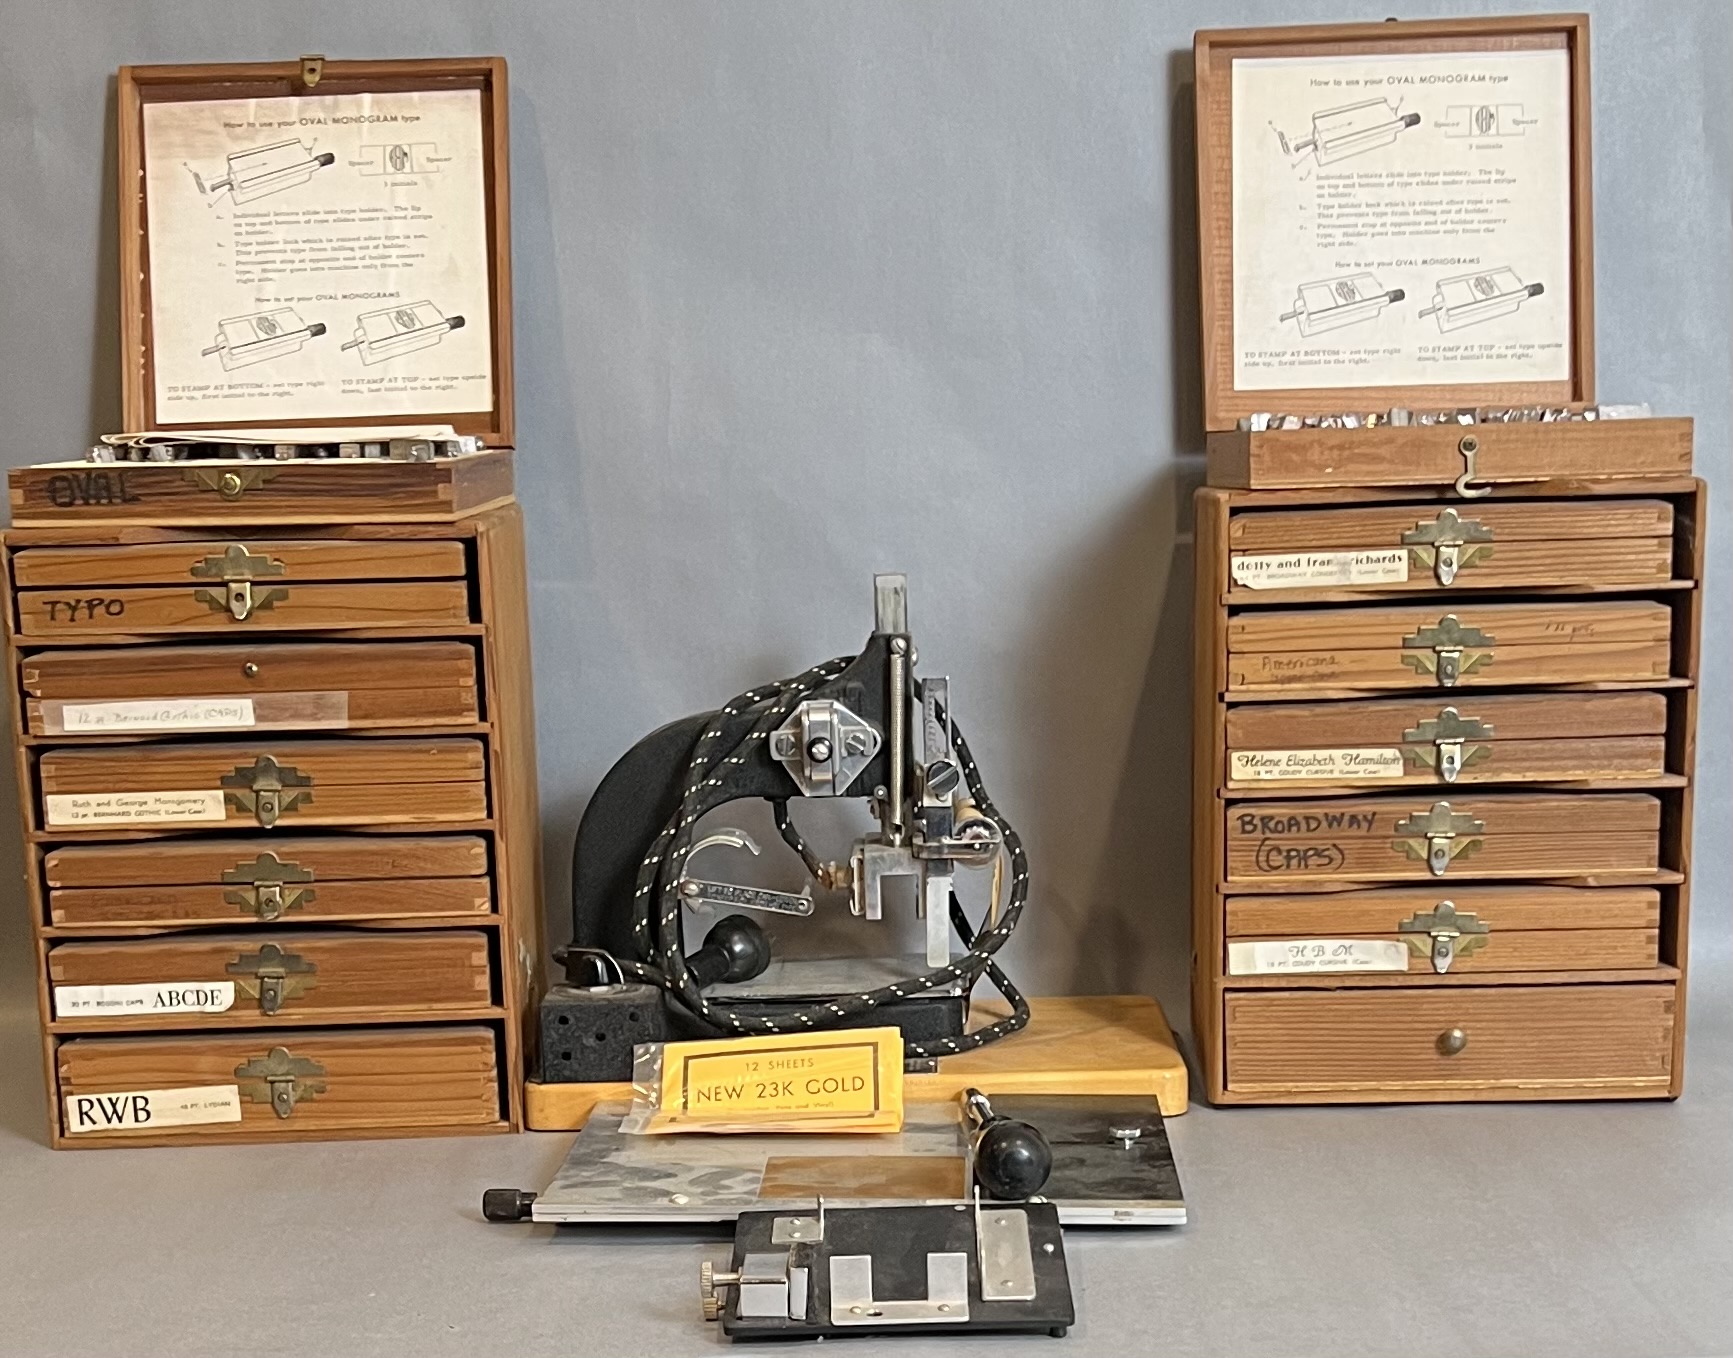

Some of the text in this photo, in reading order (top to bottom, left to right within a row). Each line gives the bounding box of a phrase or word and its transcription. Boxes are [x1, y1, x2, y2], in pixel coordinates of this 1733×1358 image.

[1310, 78, 1330, 88] How
[1333, 78, 1342, 86] to
[1386, 76, 1416, 86] OVAL
[1419, 74, 1486, 84] MONOGRAM
[1489, 75, 1508, 84] type
[300, 118, 328, 126] OVAL
[332, 115, 398, 124] MONOGRAM
[401, 115, 420, 124] type
[1421, 257, 1480, 266] MONOGRAMS
[1290, 350, 1302, 358] AT
[1418, 346, 1430, 354] TO
[1277, 558, 1302, 570] and
[42, 597, 124, 622] TYPO
[1237, 752, 1400, 768] Helene Elizabeth Hamilton
[96, 800, 112, 808] and
[116, 798, 148, 808] George
[1237, 812, 1376, 836] BROADWAY
[1256, 837, 1346, 872] (CAPS)
[1288, 944, 1306, 958] H
[1312, 944, 1326, 958] B
[152, 988, 224, 1008] ABCDE
[745, 1057, 814, 1072] 12 SHEETS
[697, 1076, 866, 1104] NEW 23K GOLD
[77, 1095, 152, 1126] RWB
